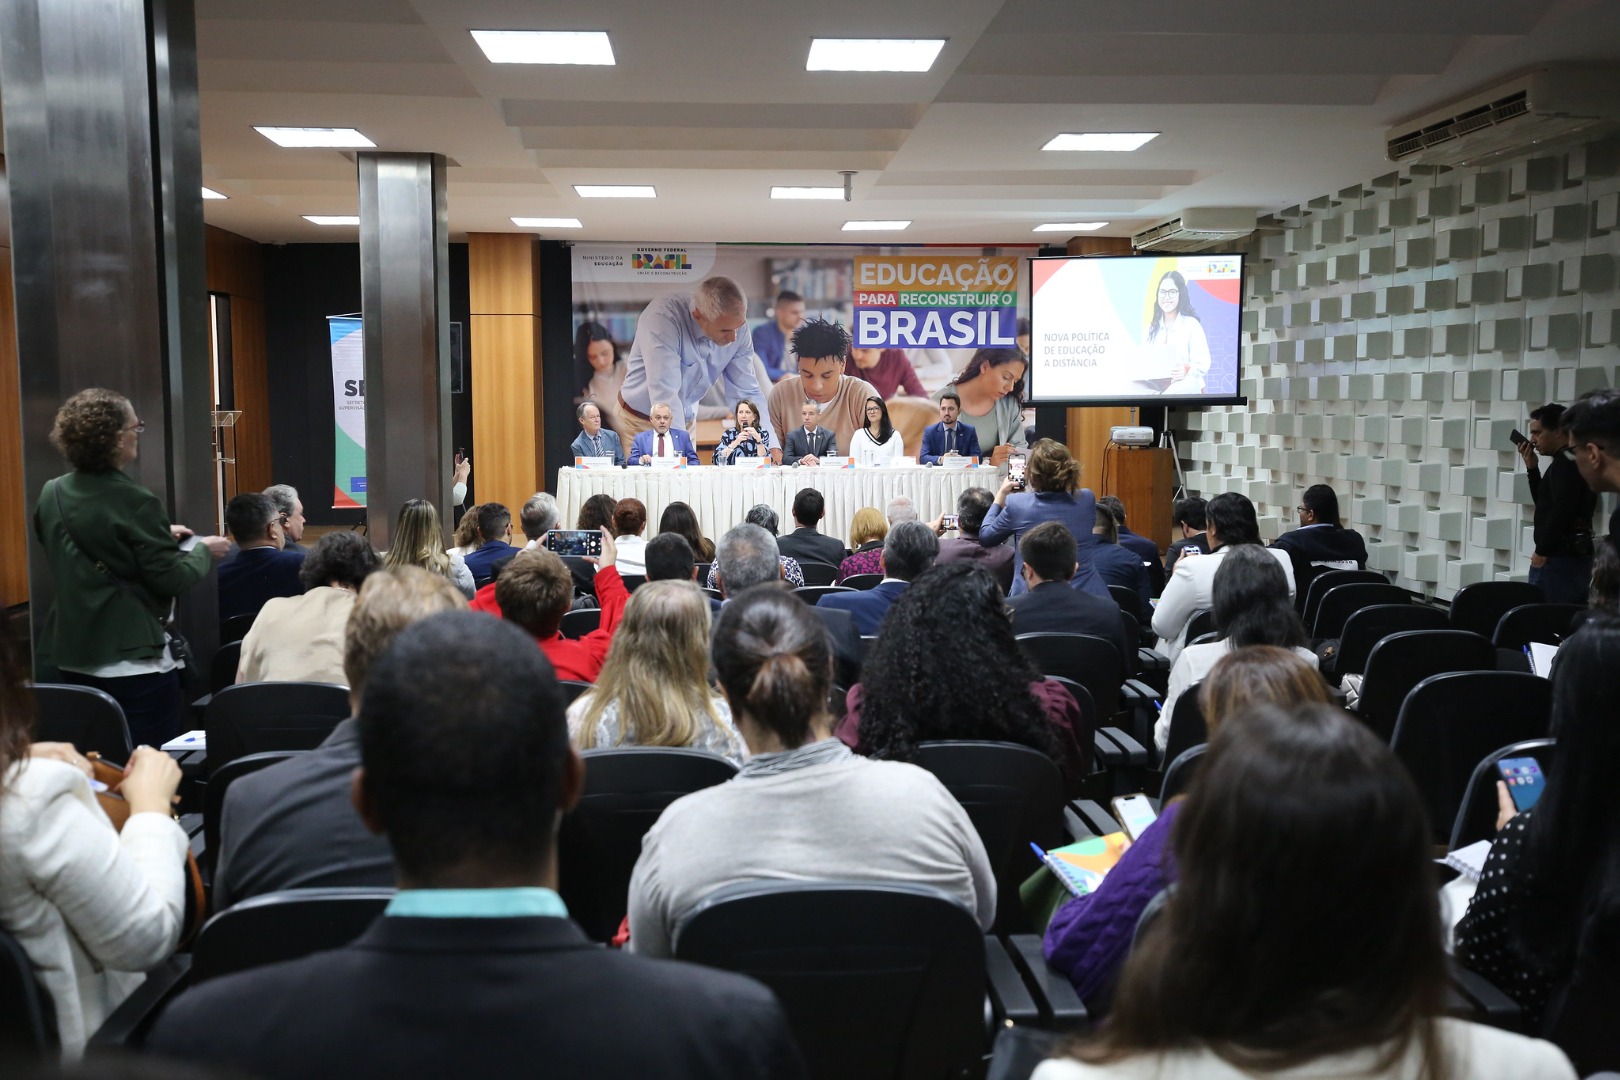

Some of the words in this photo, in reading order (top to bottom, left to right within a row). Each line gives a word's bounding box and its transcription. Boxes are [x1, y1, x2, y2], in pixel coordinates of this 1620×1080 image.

[632, 254, 692, 269] BRASIL
[860, 258, 1014, 291] EDUCAÇÃO
[859, 293, 896, 305] PARA
[900, 293, 999, 305] RECONSTRUIR
[1001, 293, 1012, 305] O
[859, 310, 1015, 346] BRASIL
[1044, 333, 1069, 341] NOVA
[1071, 331, 1110, 341] POLÍTICA
[1044, 346, 1055, 354] DE
[1057, 344, 1105, 356] EDUCAÇÃO
[1044, 359, 1050, 367] A
[1052, 357, 1098, 367] DISTÂNCIA
